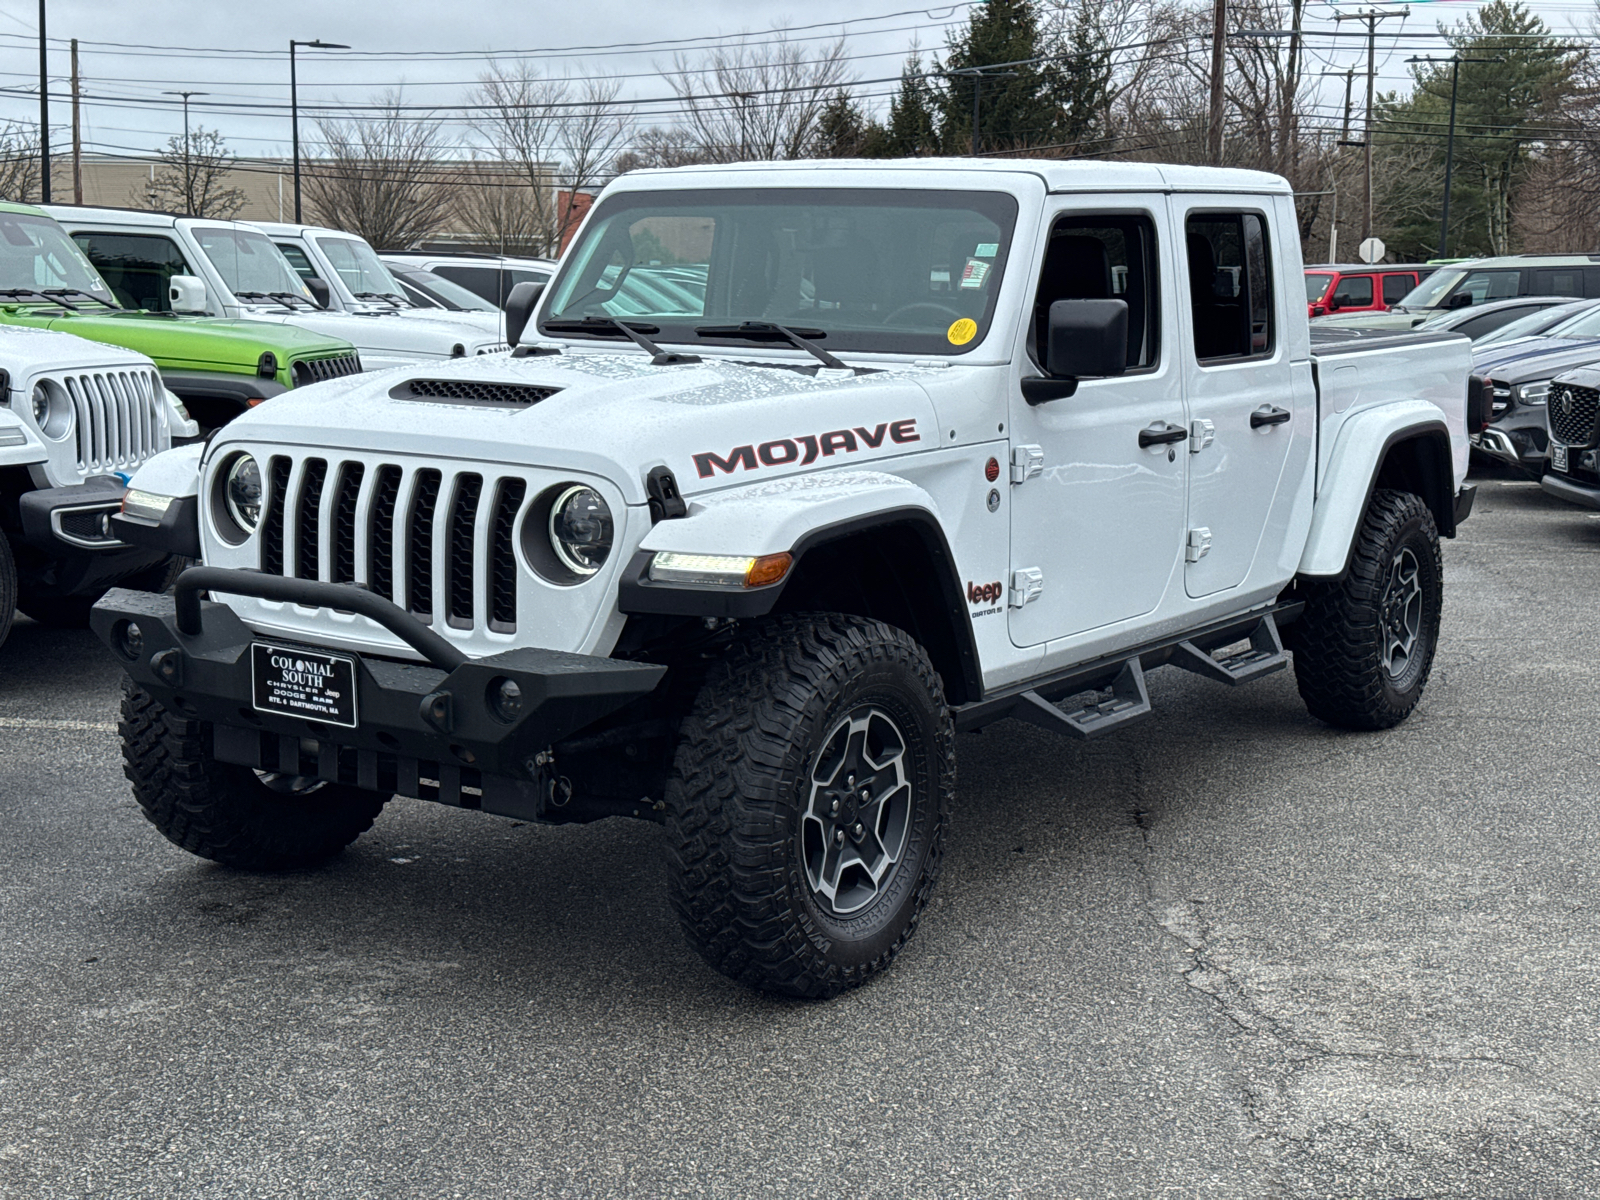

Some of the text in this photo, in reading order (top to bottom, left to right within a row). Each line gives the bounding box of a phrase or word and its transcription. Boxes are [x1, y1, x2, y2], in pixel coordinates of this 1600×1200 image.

[691, 418, 921, 479] MOJAVE
[967, 580, 1003, 606] Jeep
[270, 655, 335, 678] COLONIAL
[282, 669, 324, 688] SOUTH
[266, 680, 341, 700] CHRYSLER Jeep
[273, 688, 334, 705] DODGE RAM
[329, 706, 340, 715] MA
